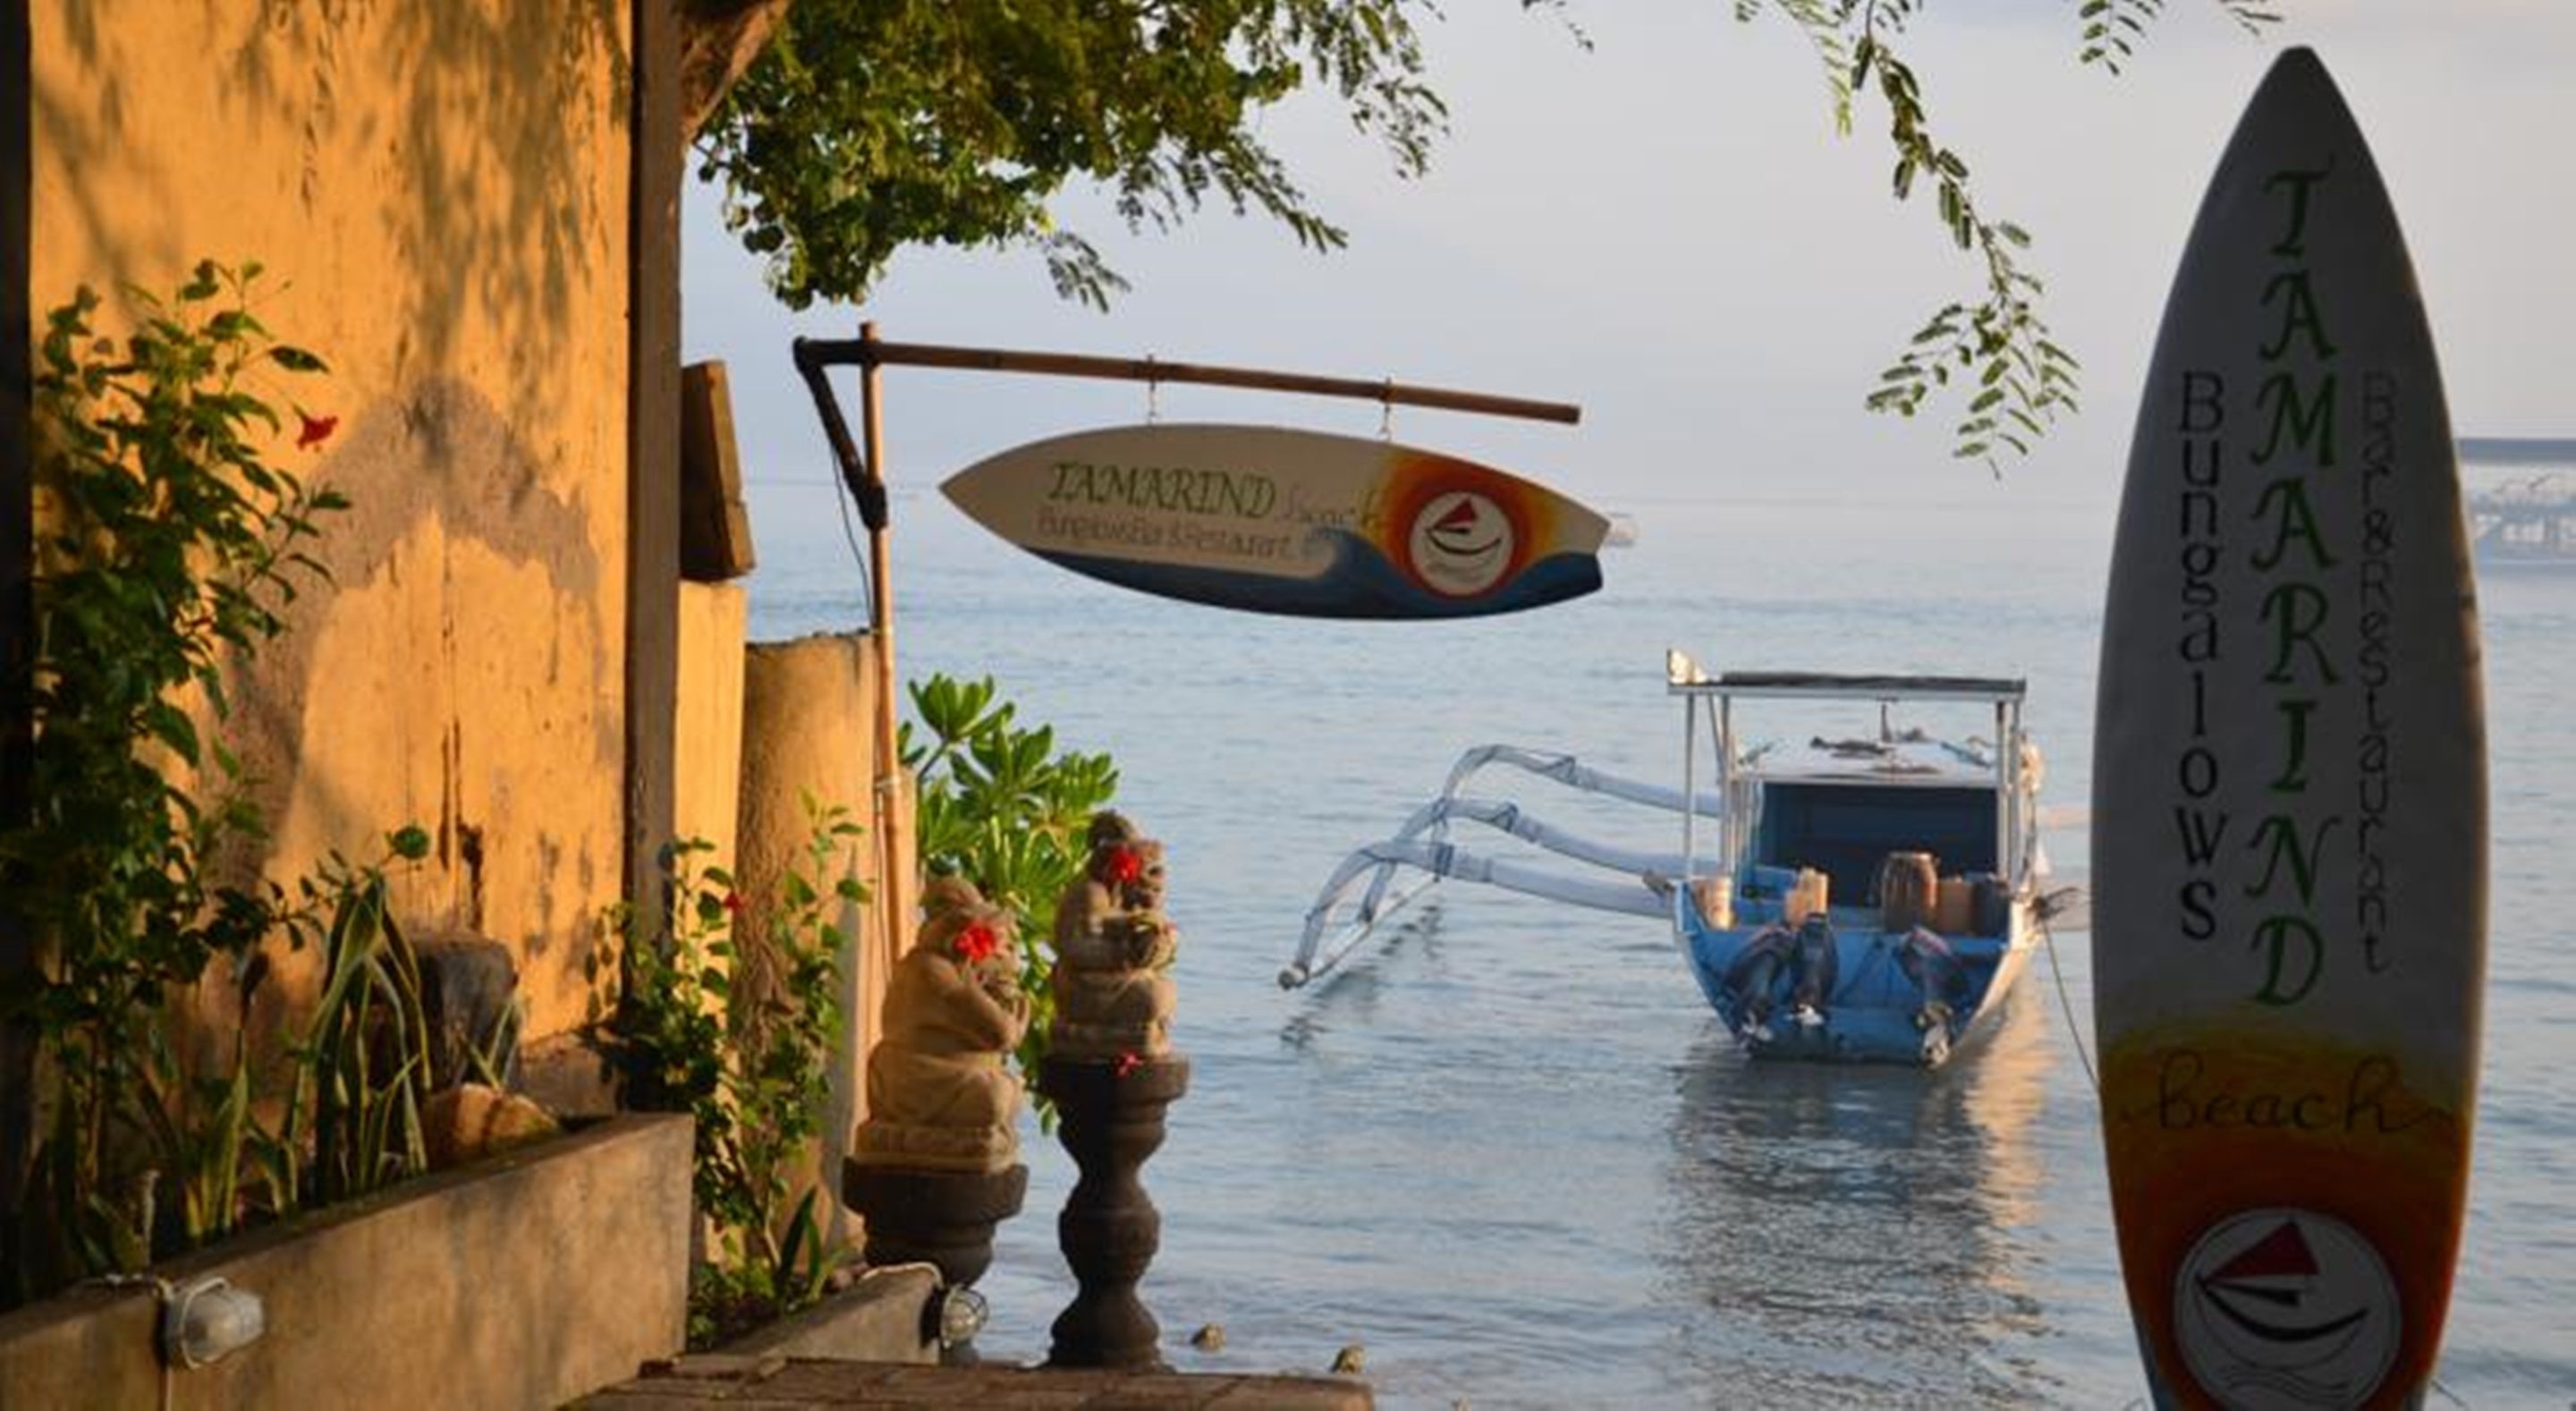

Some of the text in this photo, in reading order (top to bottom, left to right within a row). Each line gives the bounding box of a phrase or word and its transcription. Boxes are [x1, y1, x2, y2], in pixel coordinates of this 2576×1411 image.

[1047, 462, 1275, 519] TAMARIND
[2175, 370, 2228, 941] Bungalows
[2243, 154, 2341, 1006] TAMARIND
[2120, 1045, 2456, 1135] beach
